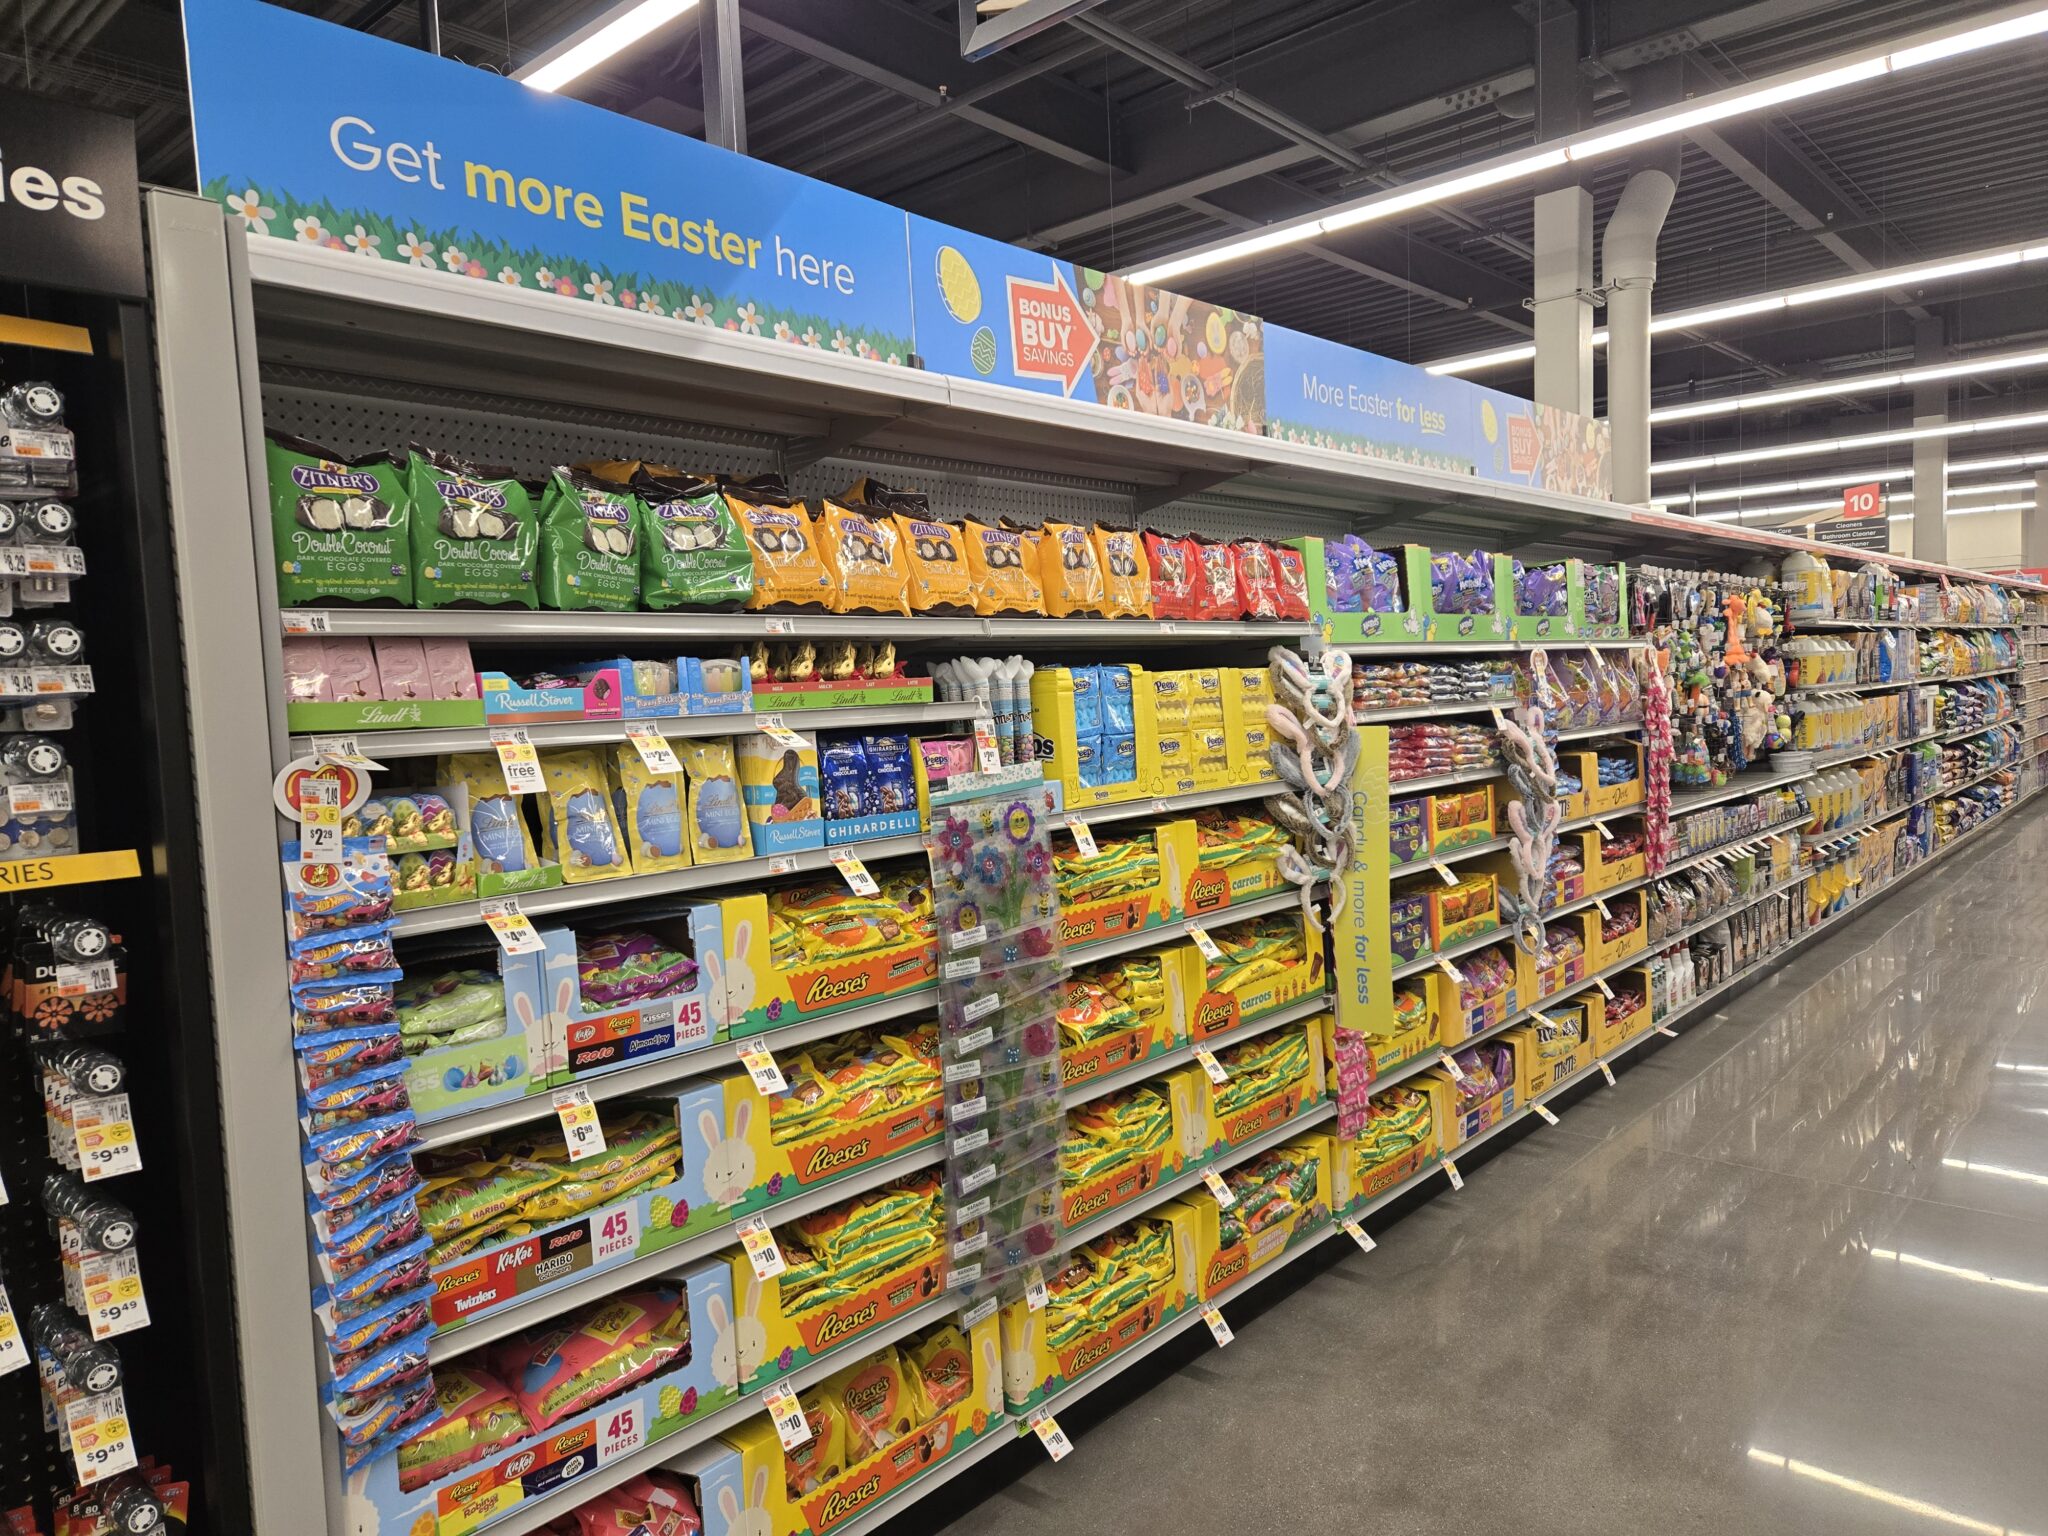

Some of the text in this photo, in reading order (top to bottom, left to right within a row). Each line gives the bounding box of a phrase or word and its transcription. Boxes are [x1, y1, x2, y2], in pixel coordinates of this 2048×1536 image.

[329, 115, 856, 296] Get more Easter here
[1019, 298, 1071, 322] BONUS
[1021, 318, 1072, 350] BUY
[1023, 349, 1074, 367] SAVINGS
[1302, 372, 1446, 431] More Easter for less
[1511, 436, 1532, 455] BUY
[300, 470, 373, 492] ZITNER'S
[444, 484, 502, 506] ZITNER'S
[1850, 494, 1873, 511] 10
[1822, 529, 1876, 540] Bathroom Cleaner
[1836, 521, 1862, 529] Cleaners
[292, 531, 395, 555] Double Coconut
[434, 540, 479, 562] Double
[327, 562, 365, 572] EGGS
[465, 569, 499, 577] EGGS
[597, 580, 621, 589] EGGS
[1155, 680, 1179, 694] Peeps
[1242, 675, 1262, 688] Peeps
[495, 692, 574, 711] Russell Stover
[770, 690, 917, 708] Lindt Lindt Lindt
[357, 706, 409, 724] Lindt
[1159, 740, 1180, 754] Peeps
[1207, 736, 1224, 749] Peeps
[1246, 731, 1265, 744] Peeps
[868, 744, 905, 752] GHIRARDELLI
[1117, 743, 1135, 754] Peeps
[923, 755, 948, 766] Peeps
[508, 764, 535, 777] free
[1177, 779, 1195, 790] Peeps
[1094, 791, 1109, 800] Peeps
[705, 810, 721, 818] MINI
[483, 830, 504, 841] MINI
[770, 826, 822, 844] Russell Stover
[828, 817, 916, 838] GHIRARDELLI
[1353, 860, 1367, 873] &
[1616, 863, 1633, 881] Dove
[502, 873, 538, 891] Lindt
[1191, 879, 1226, 900] Reese's
[1232, 871, 1262, 891] carrots
[316, 899, 333, 912] HOT
[1353, 880, 1366, 928] more
[1057, 918, 1096, 941] Reese's
[1355, 934, 1370, 961] for
[1616, 939, 1631, 958] Dove
[805, 971, 870, 1004] Reese's
[1357, 967, 1371, 1005] less
[1241, 990, 1272, 1010] carrots
[608, 1016, 635, 1028] Reese's
[677, 1001, 702, 1027] 45
[1198, 1002, 1234, 1026] Reese's
[676, 1024, 706, 1040] PIECES
[1619, 1020, 1635, 1040] Dove
[326, 1047, 342, 1061] HOT
[1062, 1057, 1099, 1082] Reese's
[1531, 1072, 1547, 1083] peanut
[1531, 1080, 1545, 1092] eggs
[1232, 1115, 1263, 1141] Reese's
[806, 1138, 870, 1177] Reese's
[1368, 1171, 1395, 1194] Reese's
[472, 1201, 506, 1221] HARIBO
[1067, 1188, 1111, 1221] Reese's
[602, 1211, 628, 1239] 45
[439, 1238, 471, 1264] HARIBO
[599, 1235, 633, 1257] PIECES
[535, 1252, 573, 1275] HARIBO
[538, 1264, 571, 1282] Goldbears
[1208, 1254, 1246, 1288] Reese's
[437, 1269, 481, 1293] Reese's
[454, 1287, 497, 1313] Twizzlers
[815, 1300, 878, 1347] Reese's
[1068, 1338, 1112, 1375] Reese's
[845, 1376, 890, 1409] Reese's
[608, 1409, 633, 1439] 45
[779, 1414, 801, 1432] 2/$10
[554, 1429, 589, 1452] Reese's
[605, 1433, 638, 1456] PIECES
[565, 1458, 579, 1471] mini
[567, 1463, 582, 1477] eggs
[85, 1505, 98, 1514] 80
[820, 1474, 881, 1527] Reese's
